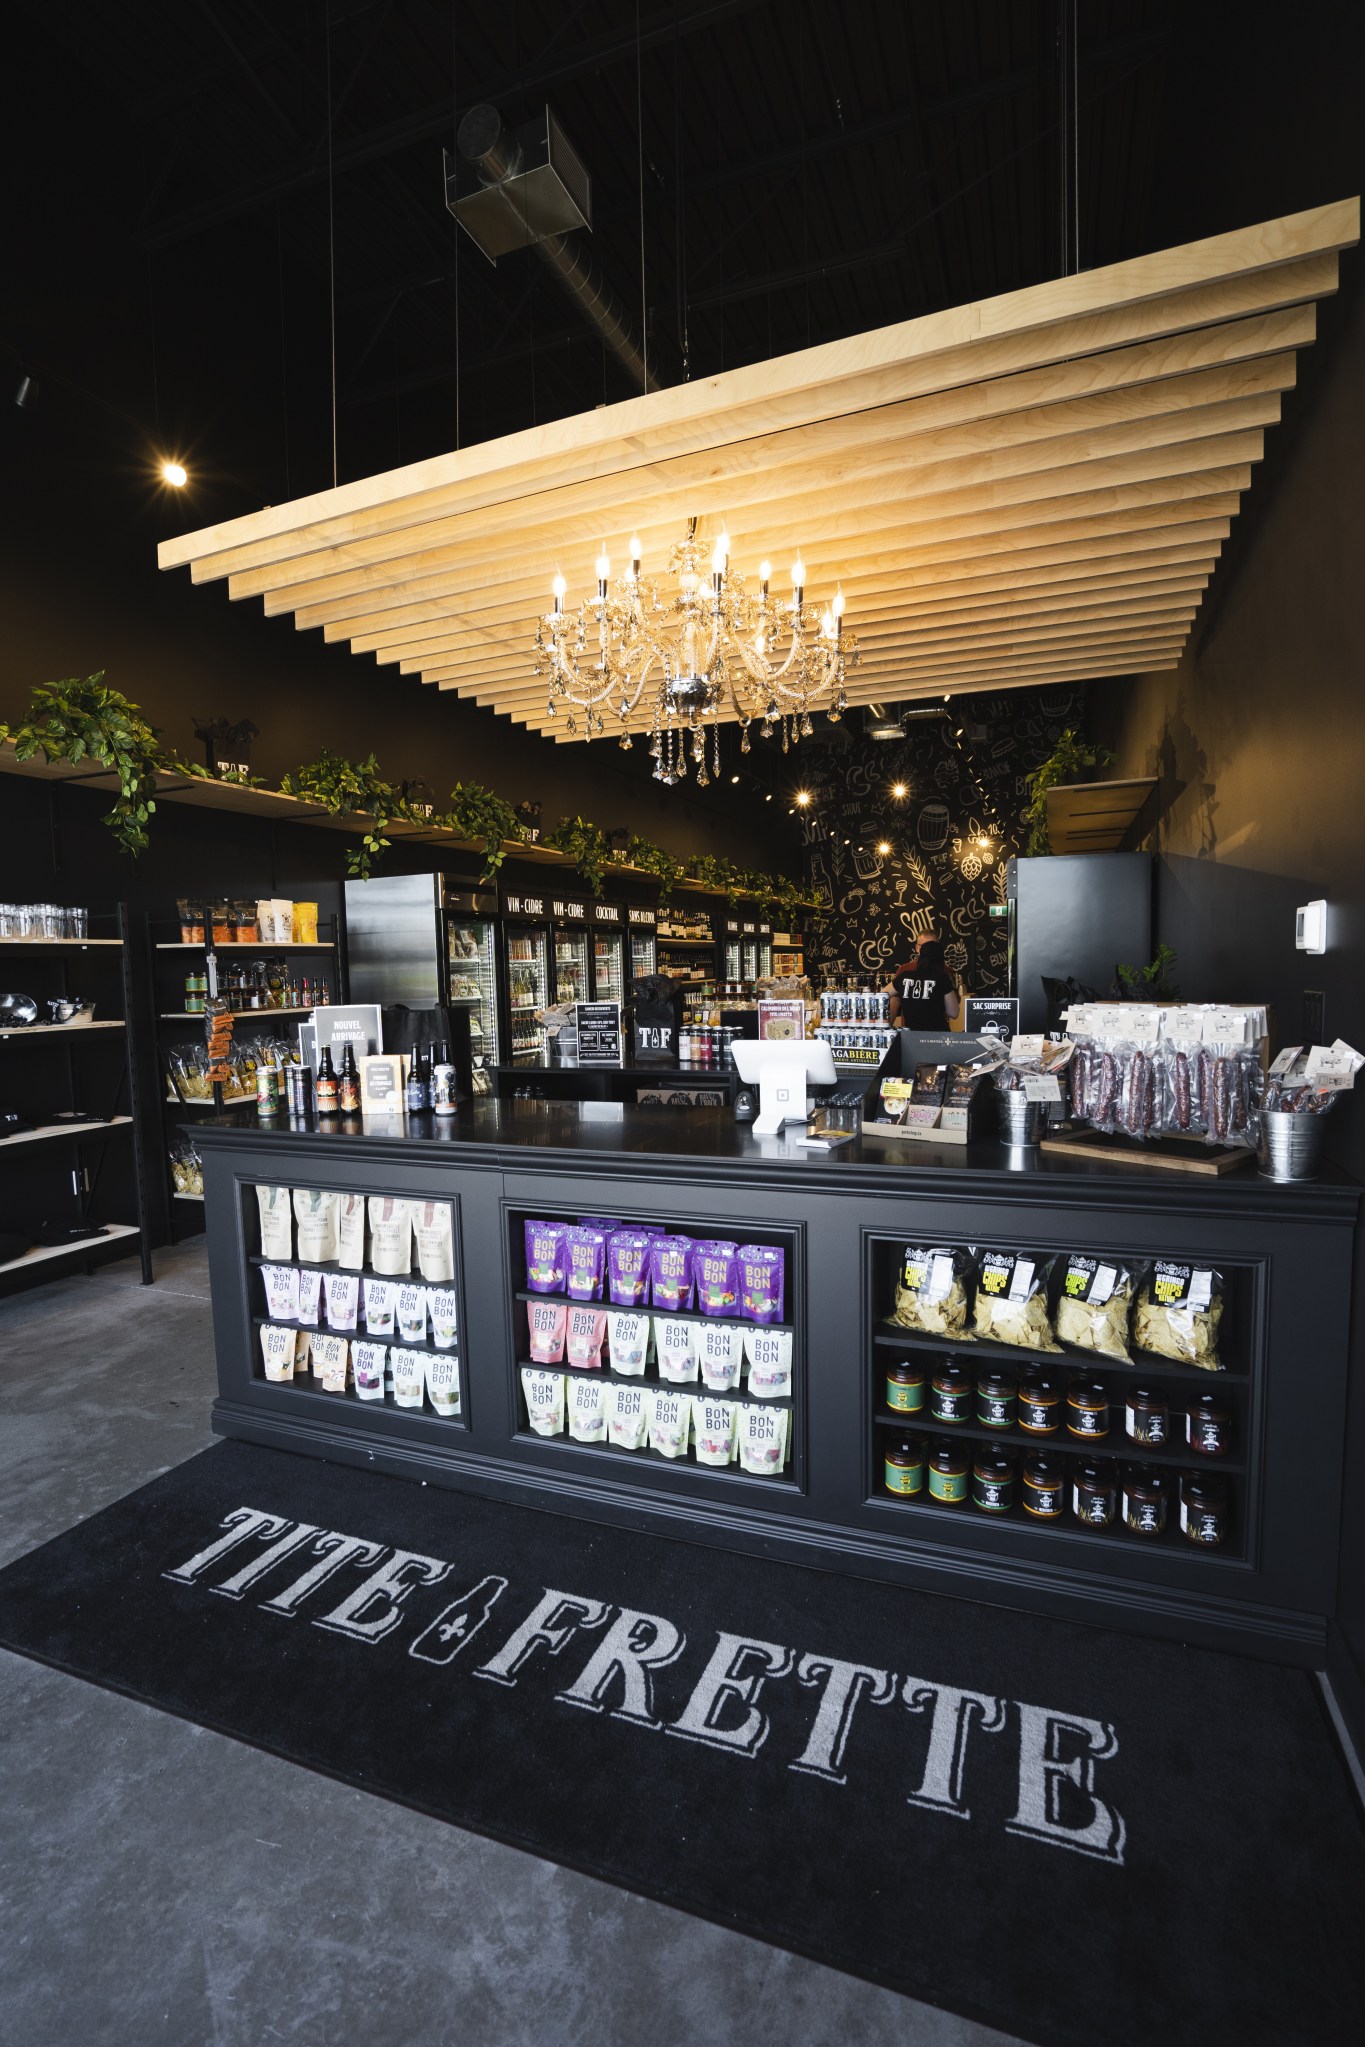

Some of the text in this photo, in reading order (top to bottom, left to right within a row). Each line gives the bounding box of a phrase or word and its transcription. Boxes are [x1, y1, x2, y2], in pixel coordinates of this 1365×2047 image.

[507, 897, 543, 914] VIN CIDRE
[553, 901, 584, 918] VIN CIDRE
[596, 906, 618, 920] COCKTAIL
[973, 1002, 1011, 1010] SAC SURPRISE
[334, 1021, 361, 1030] NOUVEL
[332, 1032, 365, 1041] ARRIVAGE
[534, 1239, 555, 1249] BON
[534, 1249, 555, 1260] BON
[573, 1245, 594, 1256] BON
[619, 1250, 641, 1261] BON
[572, 1256, 593, 1267] BON
[618, 1260, 641, 1272] BON
[705, 1259, 726, 1271] BON
[661, 1264, 684, 1276] BON
[746, 1266, 770, 1278] BON
[273, 1273, 290, 1281] BON
[302, 1275, 314, 1285] BON
[704, 1270, 726, 1282] BON
[983, 1271, 1007, 1288] CHIPS
[274, 1282, 289, 1290] BON
[332, 1281, 348, 1290] BON
[746, 1278, 770, 1289] BON
[1065, 1273, 1088, 1291] CHIPS
[301, 1284, 311, 1294] BON
[371, 1284, 386, 1295] BON
[1155, 1280, 1183, 1297] CHIPS
[331, 1290, 347, 1299] BON
[369, 1294, 385, 1304] BON
[401, 1290, 417, 1301] BON
[400, 1300, 415, 1310] BON
[435, 1296, 454, 1307] BON
[434, 1307, 453, 1317] BON
[534, 1308, 556, 1319] BON
[574, 1312, 594, 1324] BON
[534, 1318, 555, 1330] BON
[572, 1323, 594, 1334] BON
[617, 1318, 638, 1330] BON
[616, 1328, 636, 1340] BON
[666, 1325, 688, 1336] BON
[268, 1334, 286, 1343] BON
[666, 1336, 688, 1347] BON
[707, 1333, 730, 1345] BON
[268, 1343, 284, 1352] BON
[327, 1341, 341, 1351] BON
[707, 1344, 730, 1356] BON
[755, 1339, 778, 1350] BON
[325, 1351, 338, 1361] BON
[358, 1349, 374, 1360] BON
[754, 1350, 778, 1362] BON
[357, 1359, 373, 1369] BON
[398, 1355, 415, 1366] BON
[397, 1365, 413, 1376] BON
[433, 1364, 453, 1374] BON
[433, 1374, 452, 1384] BON
[532, 1383, 552, 1394] BON
[578, 1386, 598, 1397] BON
[532, 1393, 552, 1403] BON
[577, 1396, 598, 1408] BON
[618, 1392, 640, 1403] BON
[618, 1402, 640, 1413] BON
[656, 1400, 678, 1412] BON
[656, 1411, 677, 1423] BON
[706, 1407, 730, 1419] BON
[706, 1418, 730, 1430] BON
[750, 1426, 774, 1438] BON
[161, 1506, 454, 1643] TITE
[473, 1587, 1127, 1866] FRETTE
